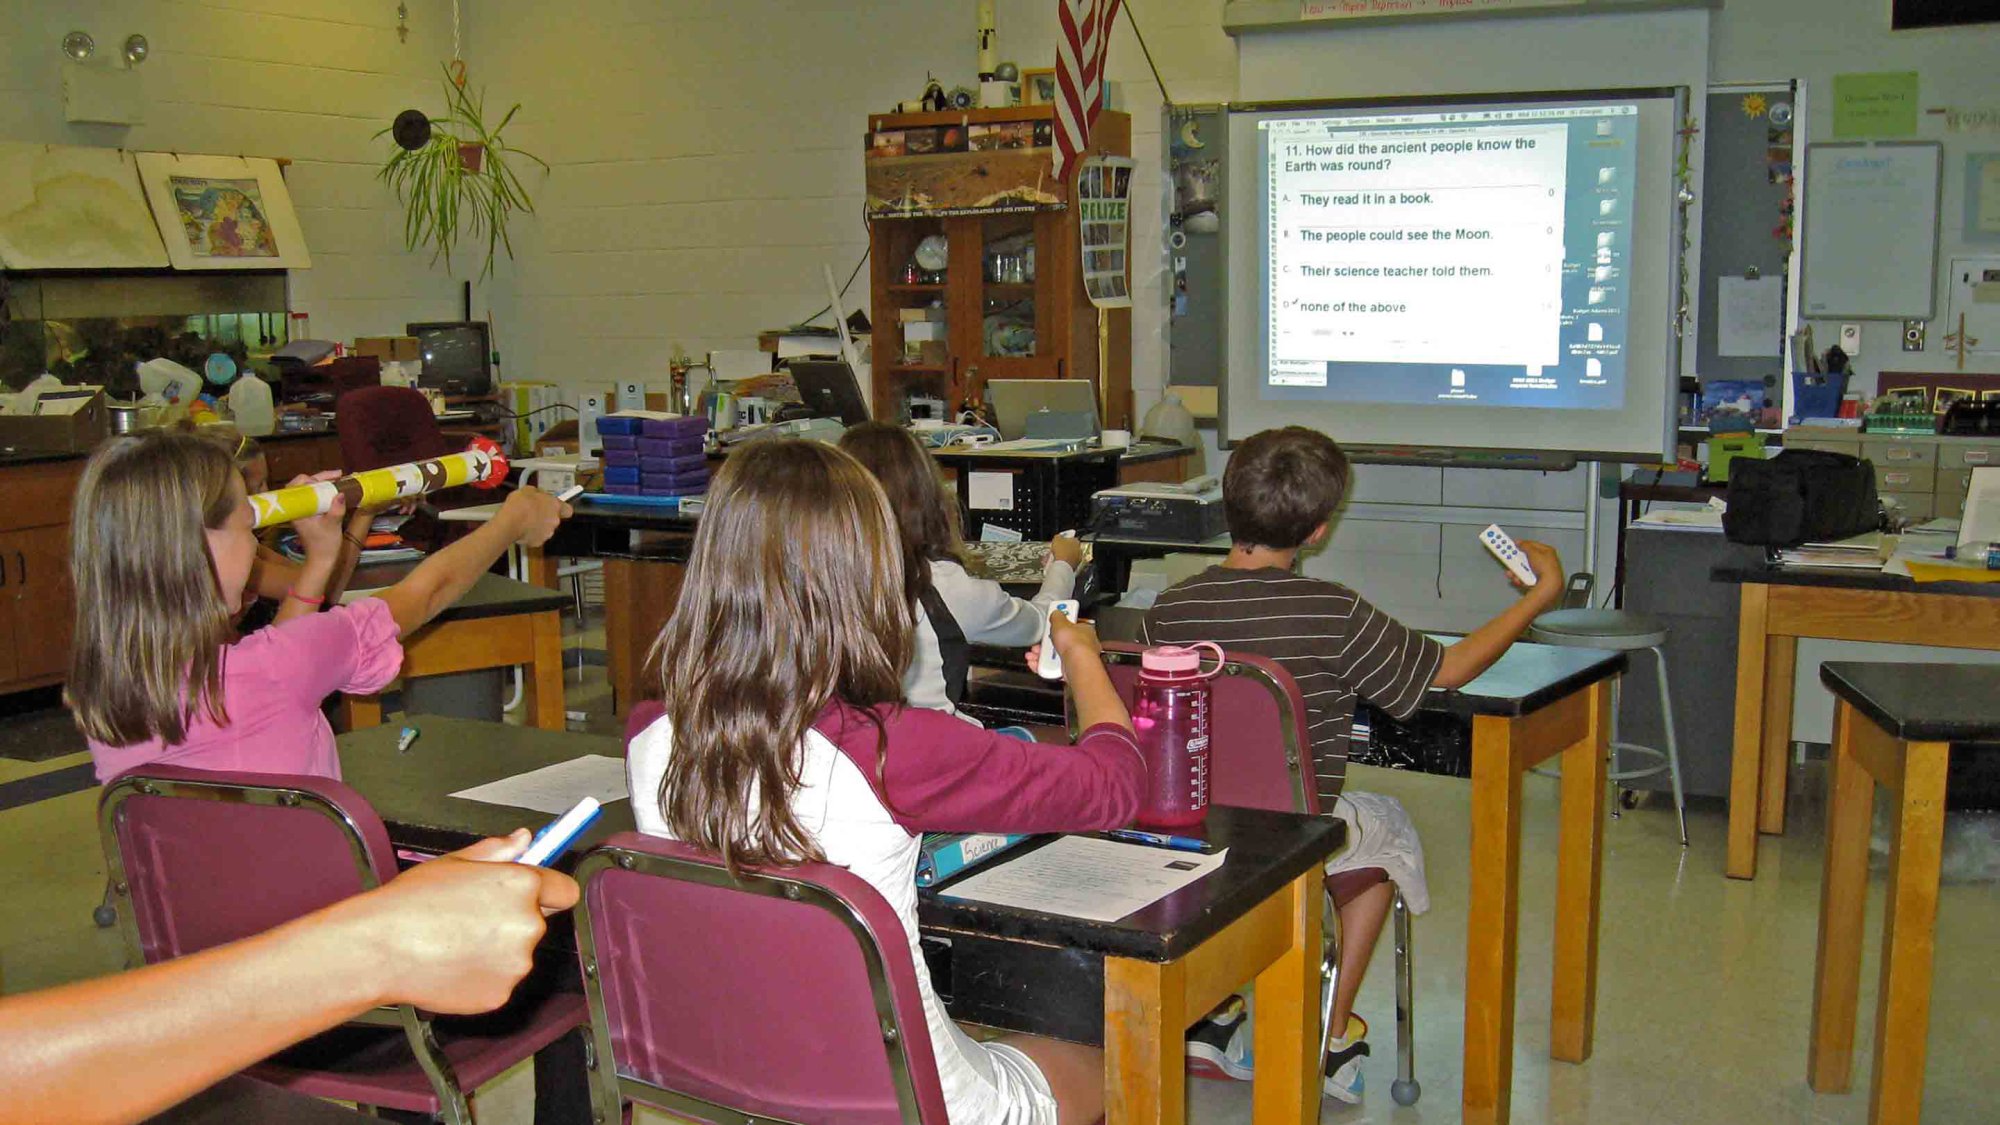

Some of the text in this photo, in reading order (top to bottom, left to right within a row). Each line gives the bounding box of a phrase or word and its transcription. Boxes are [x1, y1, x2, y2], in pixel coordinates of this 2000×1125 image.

[1286, 137, 1536, 157] 11. How did the ancient people know the
[1285, 159, 1392, 172] Earth was round?
[1300, 194, 1330, 207] They
[1333, 194, 1359, 205] read
[1363, 194, 1371, 205] it
[1374, 193, 1385, 204] in
[1389, 195, 1396, 204] a
[1400, 192, 1434, 204] book.
[1080, 201, 1127, 221] BELIZE
[1300, 230, 1323, 241] The
[1326, 230, 1366, 243] people
[1369, 229, 1403, 241] could
[1407, 230, 1429, 240] see
[1432, 229, 1452, 240] the
[1455, 229, 1494, 240] Moon.
[1300, 265, 1330, 276] Their
[1334, 265, 1380, 277] science
[1383, 265, 1428, 277] teacher
[1432, 265, 1456, 276] told
[1459, 265, 1494, 276] them.
[1300, 302, 1330, 312] none
[1333, 301, 1346, 312] of
[1348, 302, 1367, 312] the
[1370, 302, 1407, 313] above
